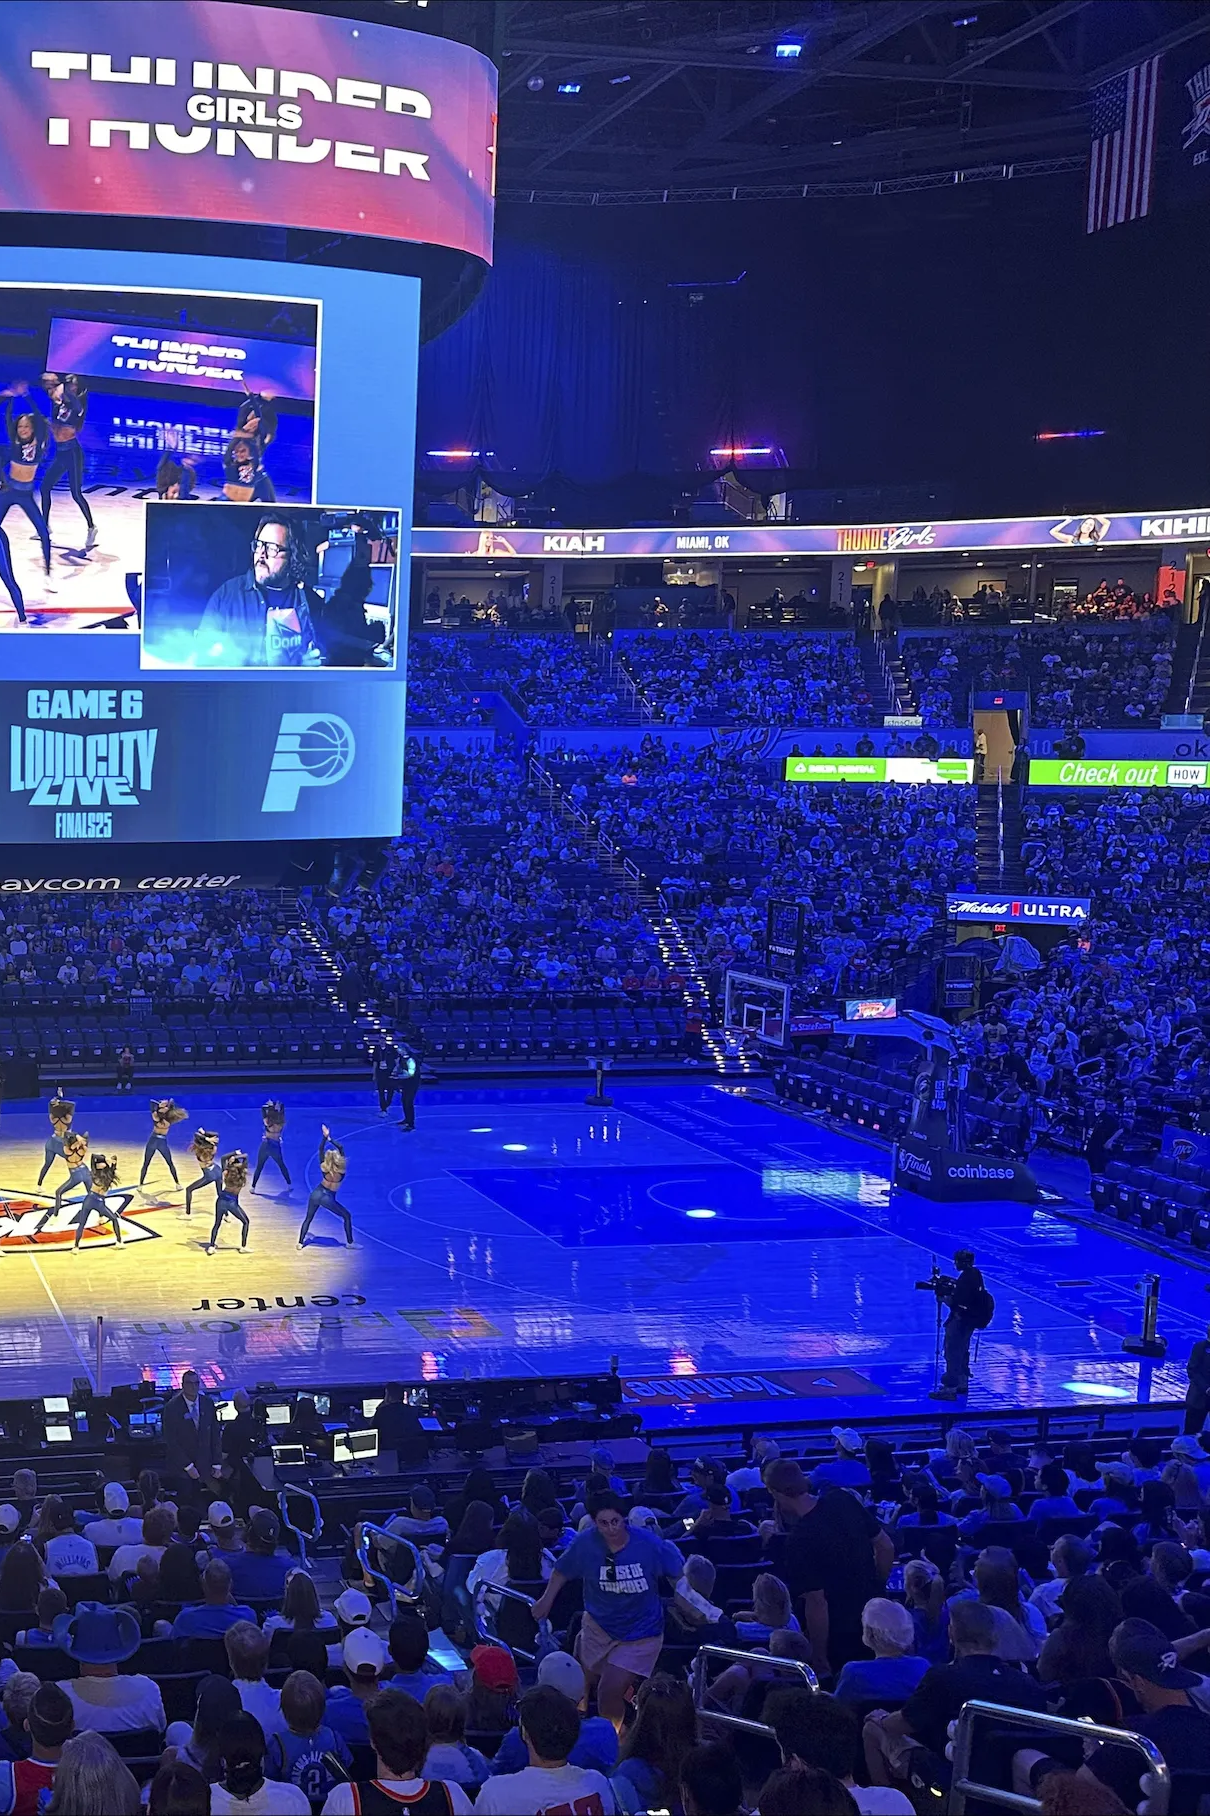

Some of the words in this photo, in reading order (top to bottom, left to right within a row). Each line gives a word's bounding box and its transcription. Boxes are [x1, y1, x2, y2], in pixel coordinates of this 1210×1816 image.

[187, 94, 302, 130] GIRLS
[543, 535, 605, 552] KIAH
[676, 536, 712, 551] MIAMI,
[714, 535, 730, 548] OK
[887, 525, 937, 552] Girls
[27, 689, 117, 719] GAME
[121, 689, 143, 719] 6
[1059, 762, 1120, 784] Check
[1125, 765, 1160, 784] out
[1173, 769, 1201, 781] HOW
[28, 776, 140, 806] LIVE
[137, 872, 241, 889] center
[949, 900, 1010, 915] Michelob
[1024, 903, 1087, 918] ULTRA
[948, 1164, 1015, 1180] coinbase
[192, 1293, 367, 1312] center
[626, 1375, 796, 1398] YouTube
[307, 1769, 321, 1796] 2
